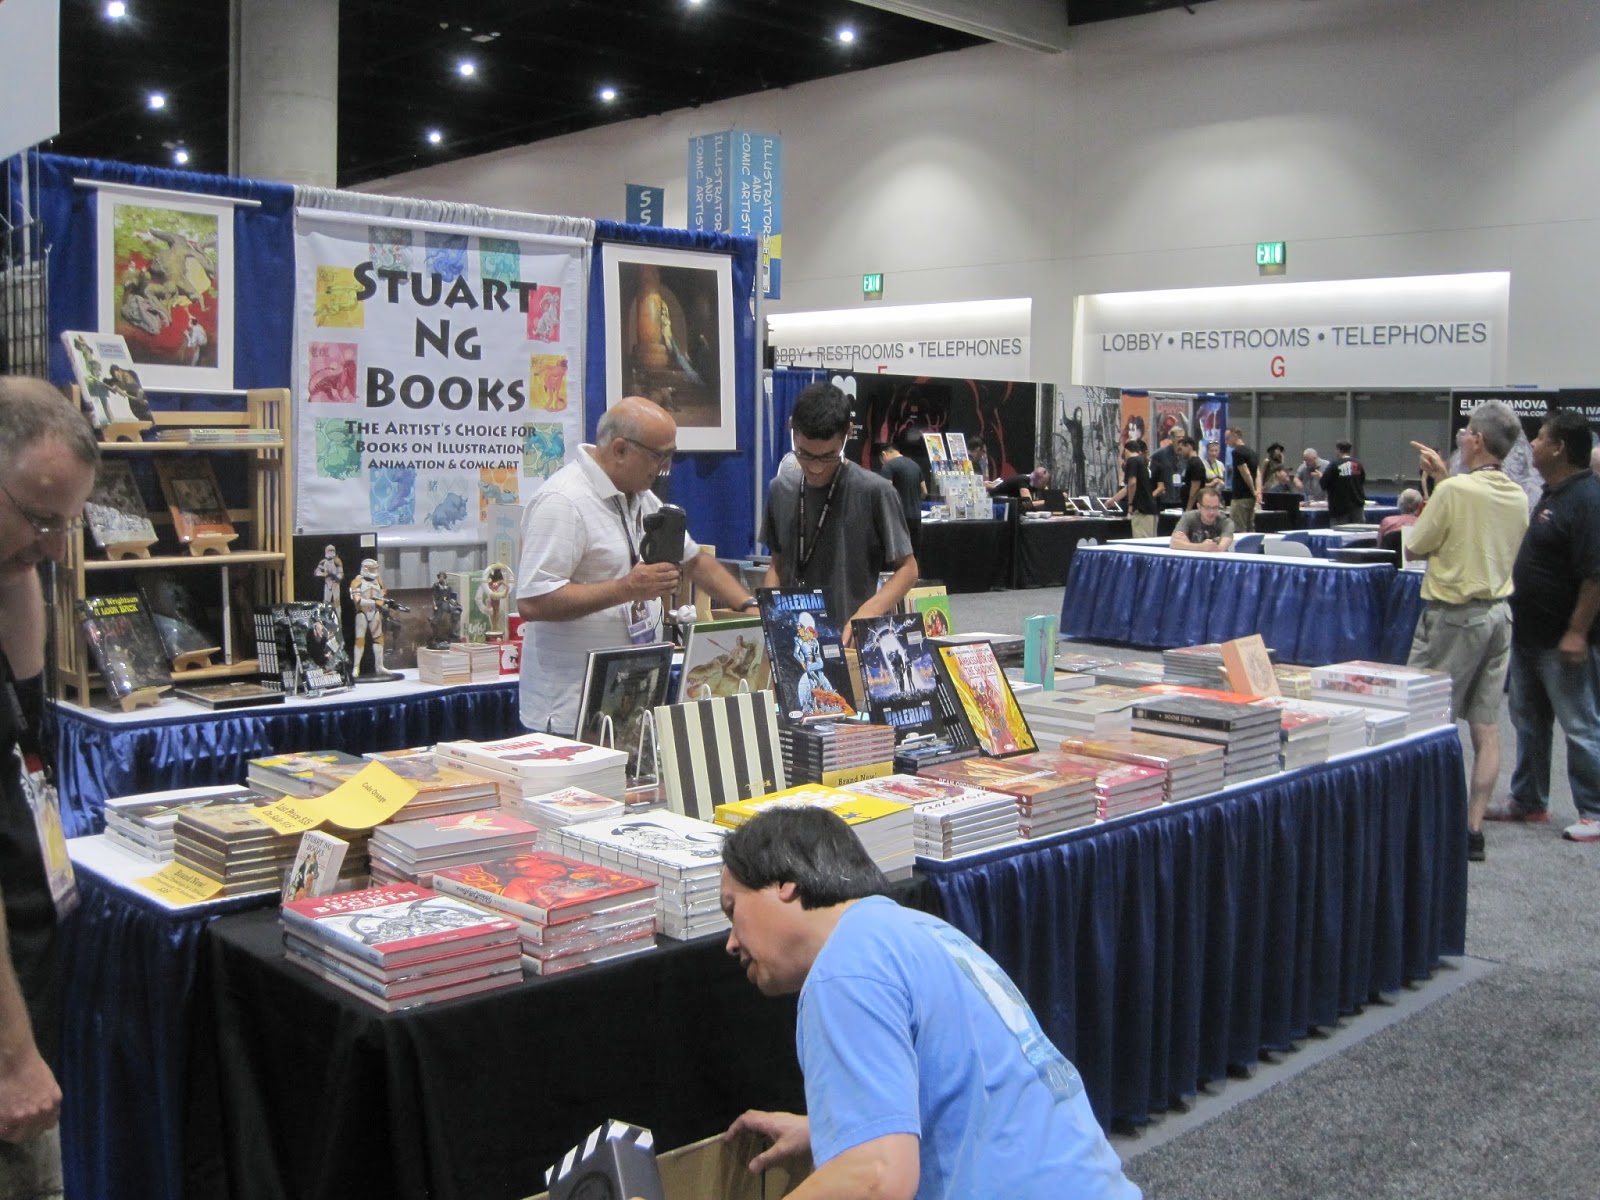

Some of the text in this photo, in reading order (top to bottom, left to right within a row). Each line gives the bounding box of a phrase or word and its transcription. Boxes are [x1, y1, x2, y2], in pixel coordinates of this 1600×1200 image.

[696, 138, 704, 180] COMIC
[705, 177, 713, 202] AND
[741, 133, 751, 237] COMIC ARTIST
[752, 175, 761, 202] AND
[1256, 243, 1282, 265] EXIT
[354, 261, 538, 314] STUART
[864, 274, 881, 292] EXIT
[415, 317, 482, 361] NG
[1102, 322, 1488, 352] LOBBY RESTROOMS TELEPHONES
[774, 337, 1023, 363] OBBY RESTROOMS TELEPHONES
[1270, 355, 1286, 379] G
[365, 366, 526, 413] BOOKS
[1460, 399, 1548, 409] ELIZ VANOVA
[345, 420, 380, 435] THE
[384, 420, 451, 436] ARTIST'S
[455, 422, 507, 438] CHOICE
[511, 425, 537, 438] FOR
[356, 440, 408, 454] BOOKS
[412, 442, 431, 455] ON
[367, 458, 520, 470] ANIMATION & COMIC ART
[772, 593, 826, 611] VALERIAN
[883, 704, 933, 727] VALERIAN
[838, 776, 858, 786] Brand
